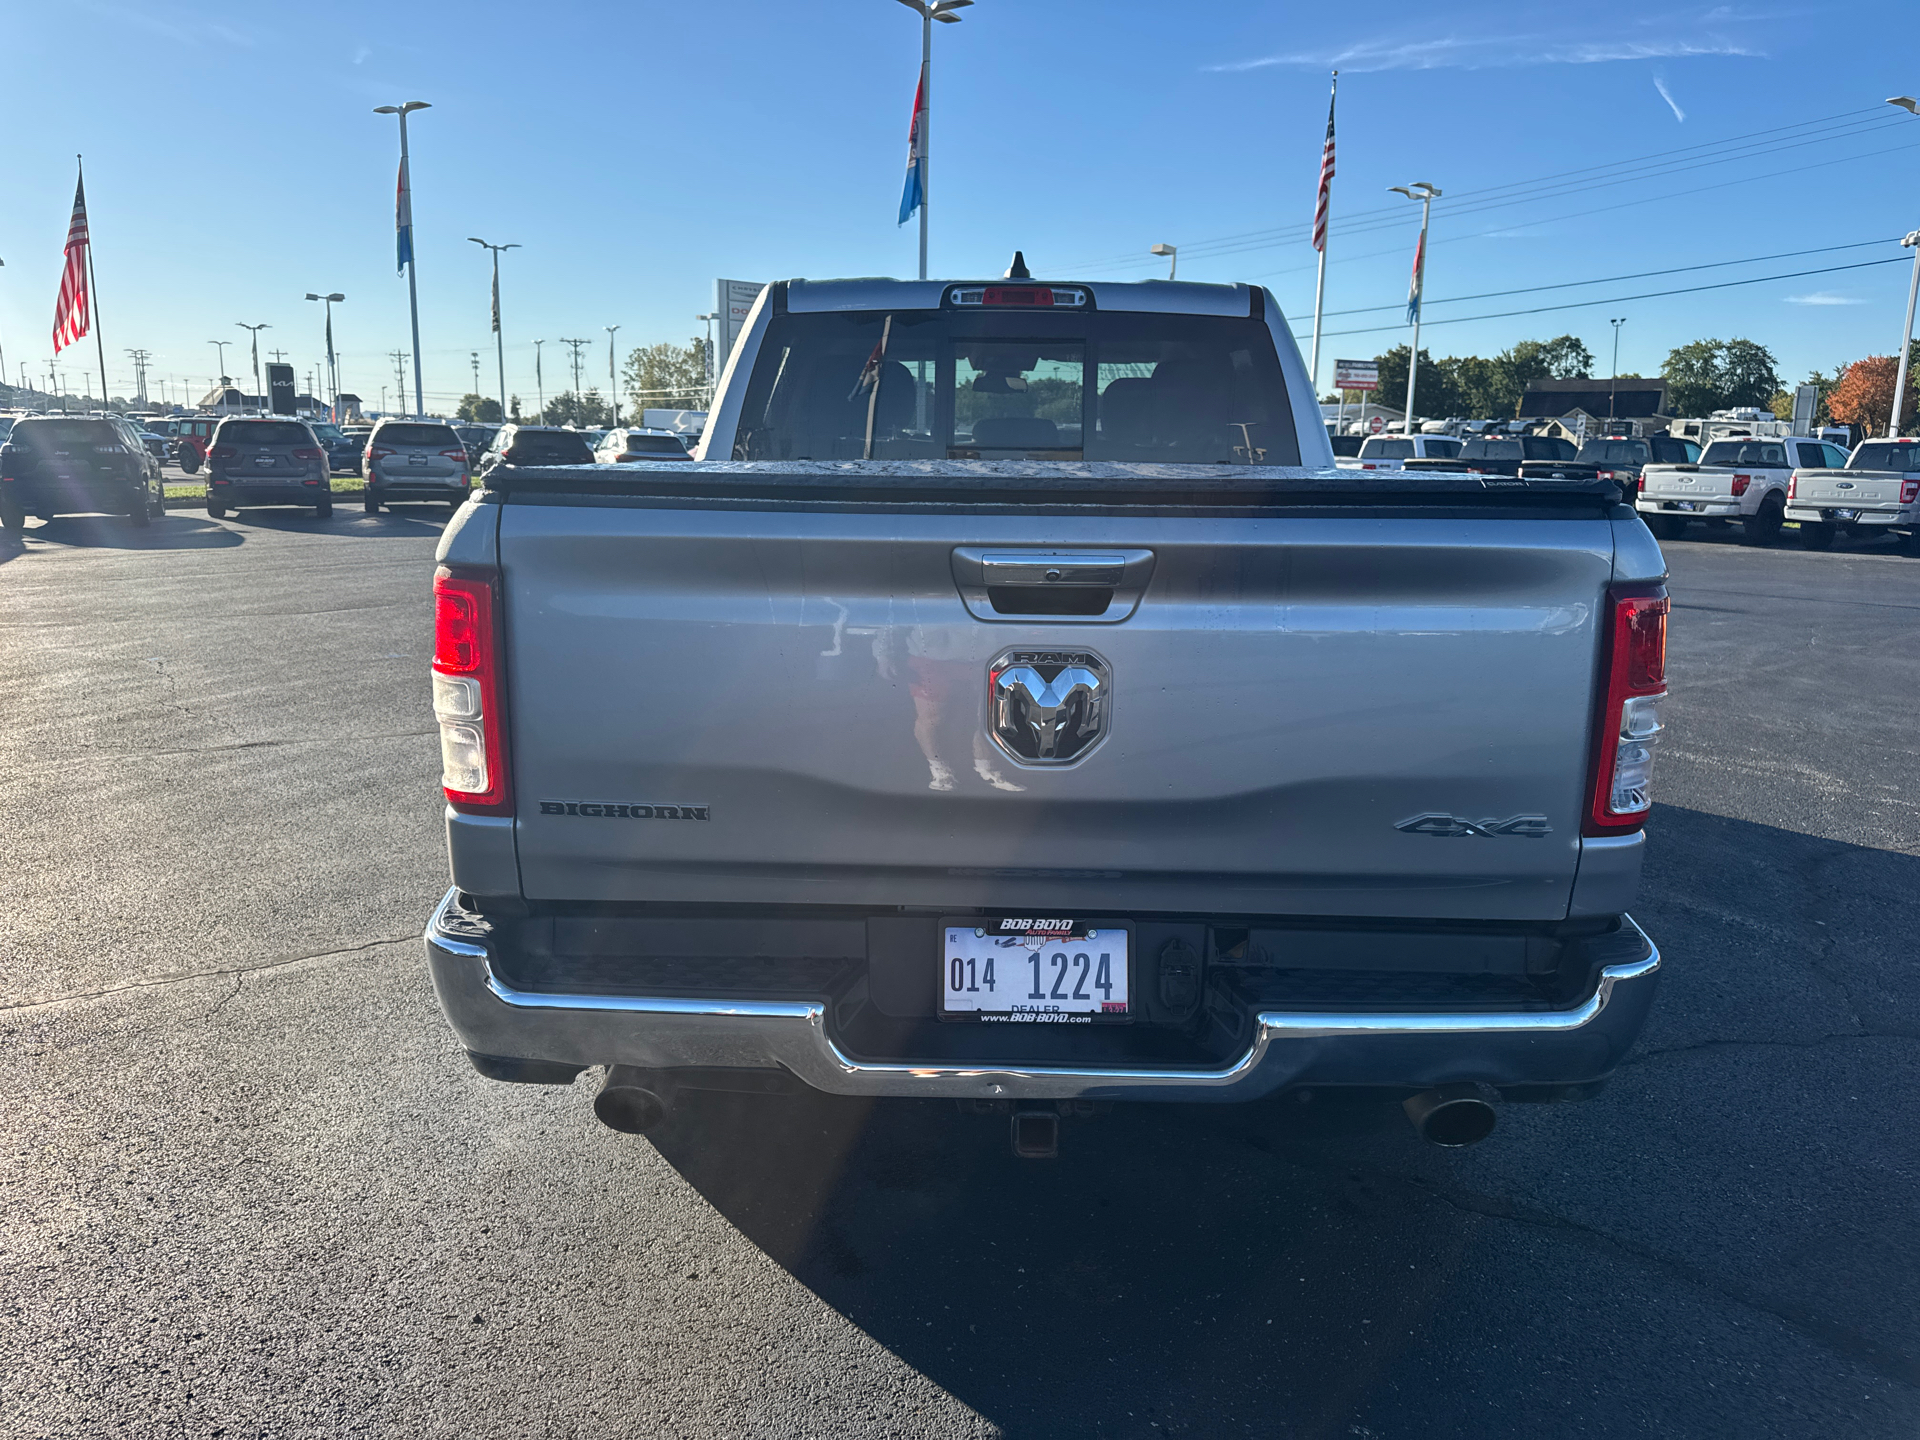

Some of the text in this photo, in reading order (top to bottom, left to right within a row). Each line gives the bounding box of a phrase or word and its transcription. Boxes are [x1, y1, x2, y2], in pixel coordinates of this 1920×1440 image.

[1013, 652, 1085, 664] RAM
[538, 799, 711, 822] BIGHORN
[951, 952, 1113, 1000] 014 1224
[1011, 1005, 1060, 1013] DEALER
